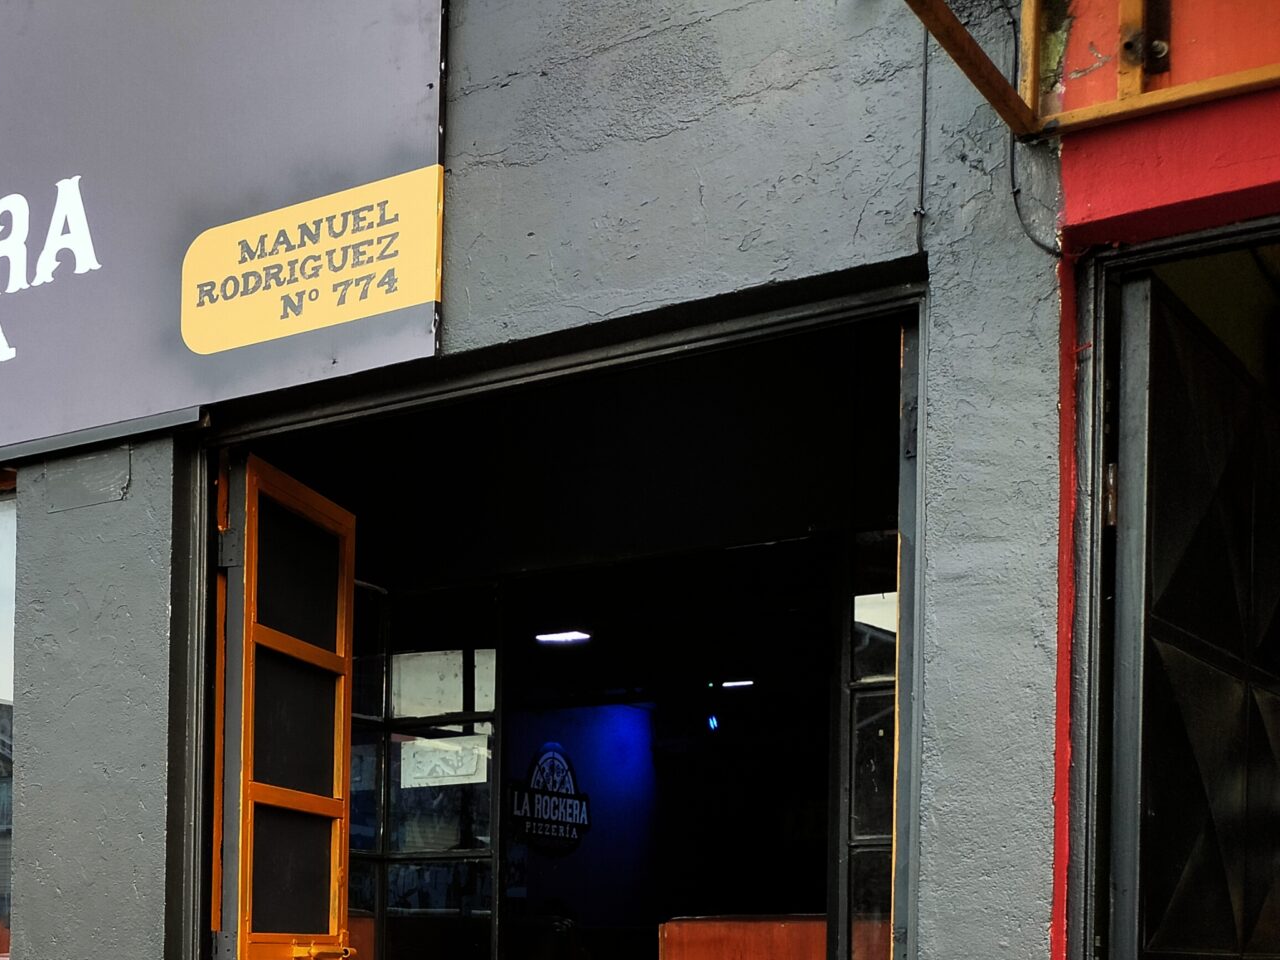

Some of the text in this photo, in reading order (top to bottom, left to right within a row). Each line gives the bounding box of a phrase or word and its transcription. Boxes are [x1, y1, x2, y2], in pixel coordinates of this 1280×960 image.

[238, 200, 399, 264] MANUEL
[196, 232, 399, 307] RODRIGUEZ
[333, 268, 398, 306] 774
[514, 791, 588, 824] LA ROCKERA
[526, 821, 578, 838] PIZZERÍA
